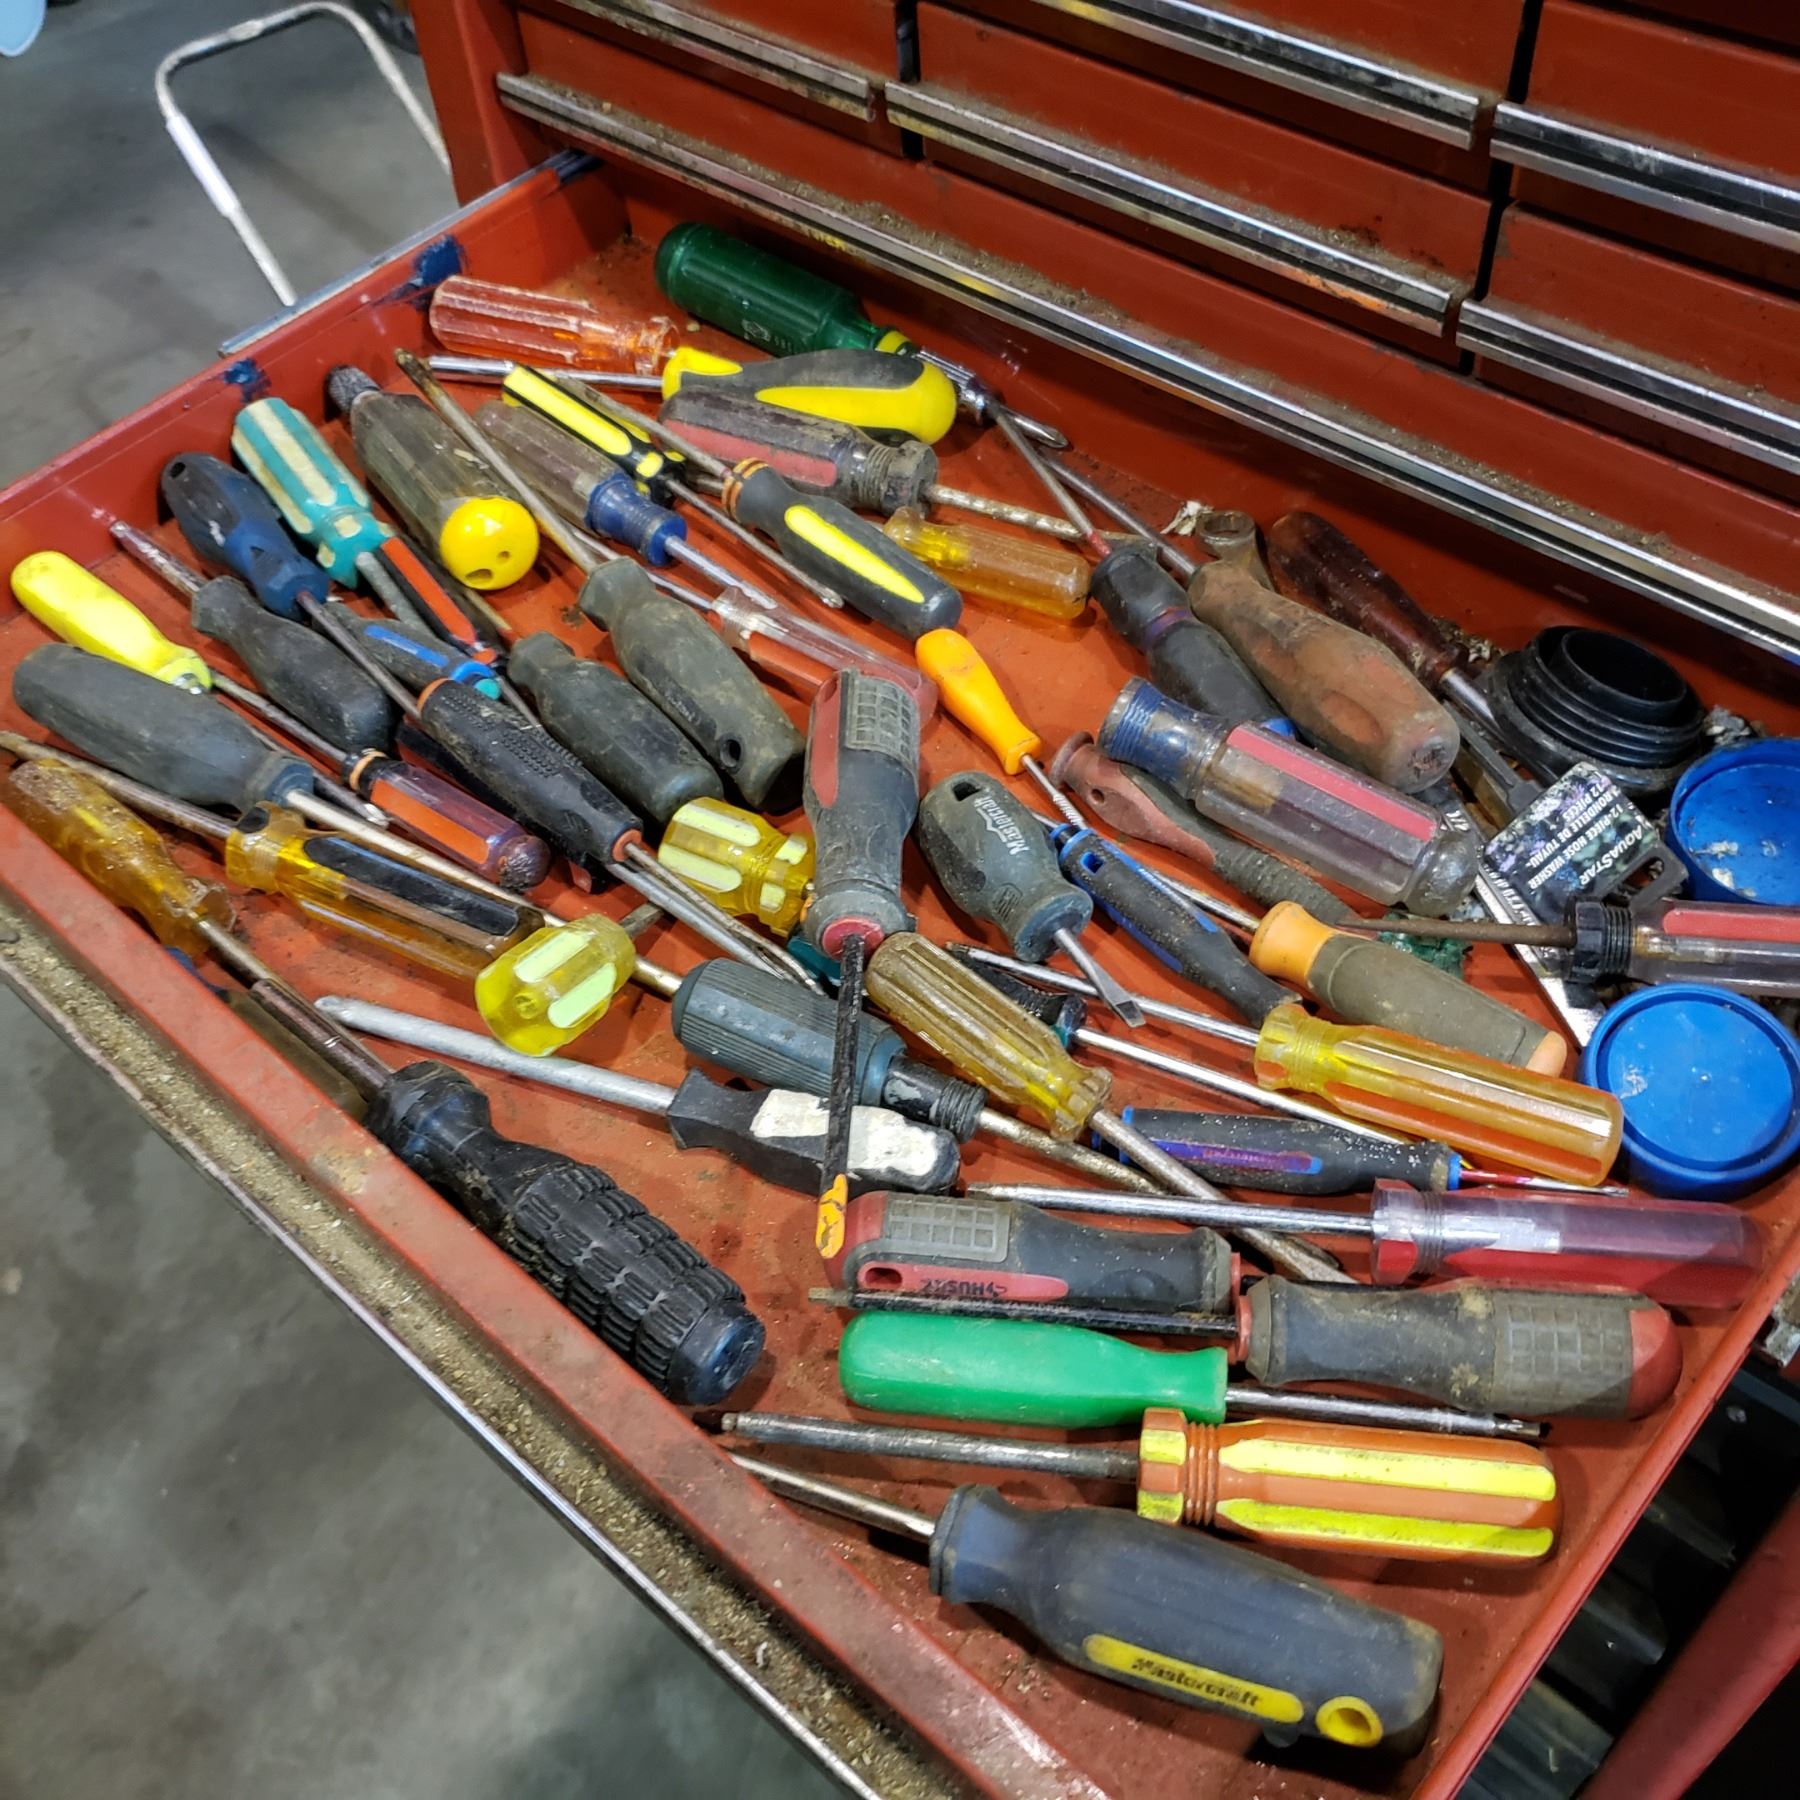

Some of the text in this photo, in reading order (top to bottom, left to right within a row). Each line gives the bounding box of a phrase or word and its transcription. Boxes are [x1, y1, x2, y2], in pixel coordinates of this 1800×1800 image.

[1590, 784, 1605, 798] 12
[1557, 828, 1573, 843] DE
[1528, 804, 1624, 889] 12-PIECE HOSE WASHER
